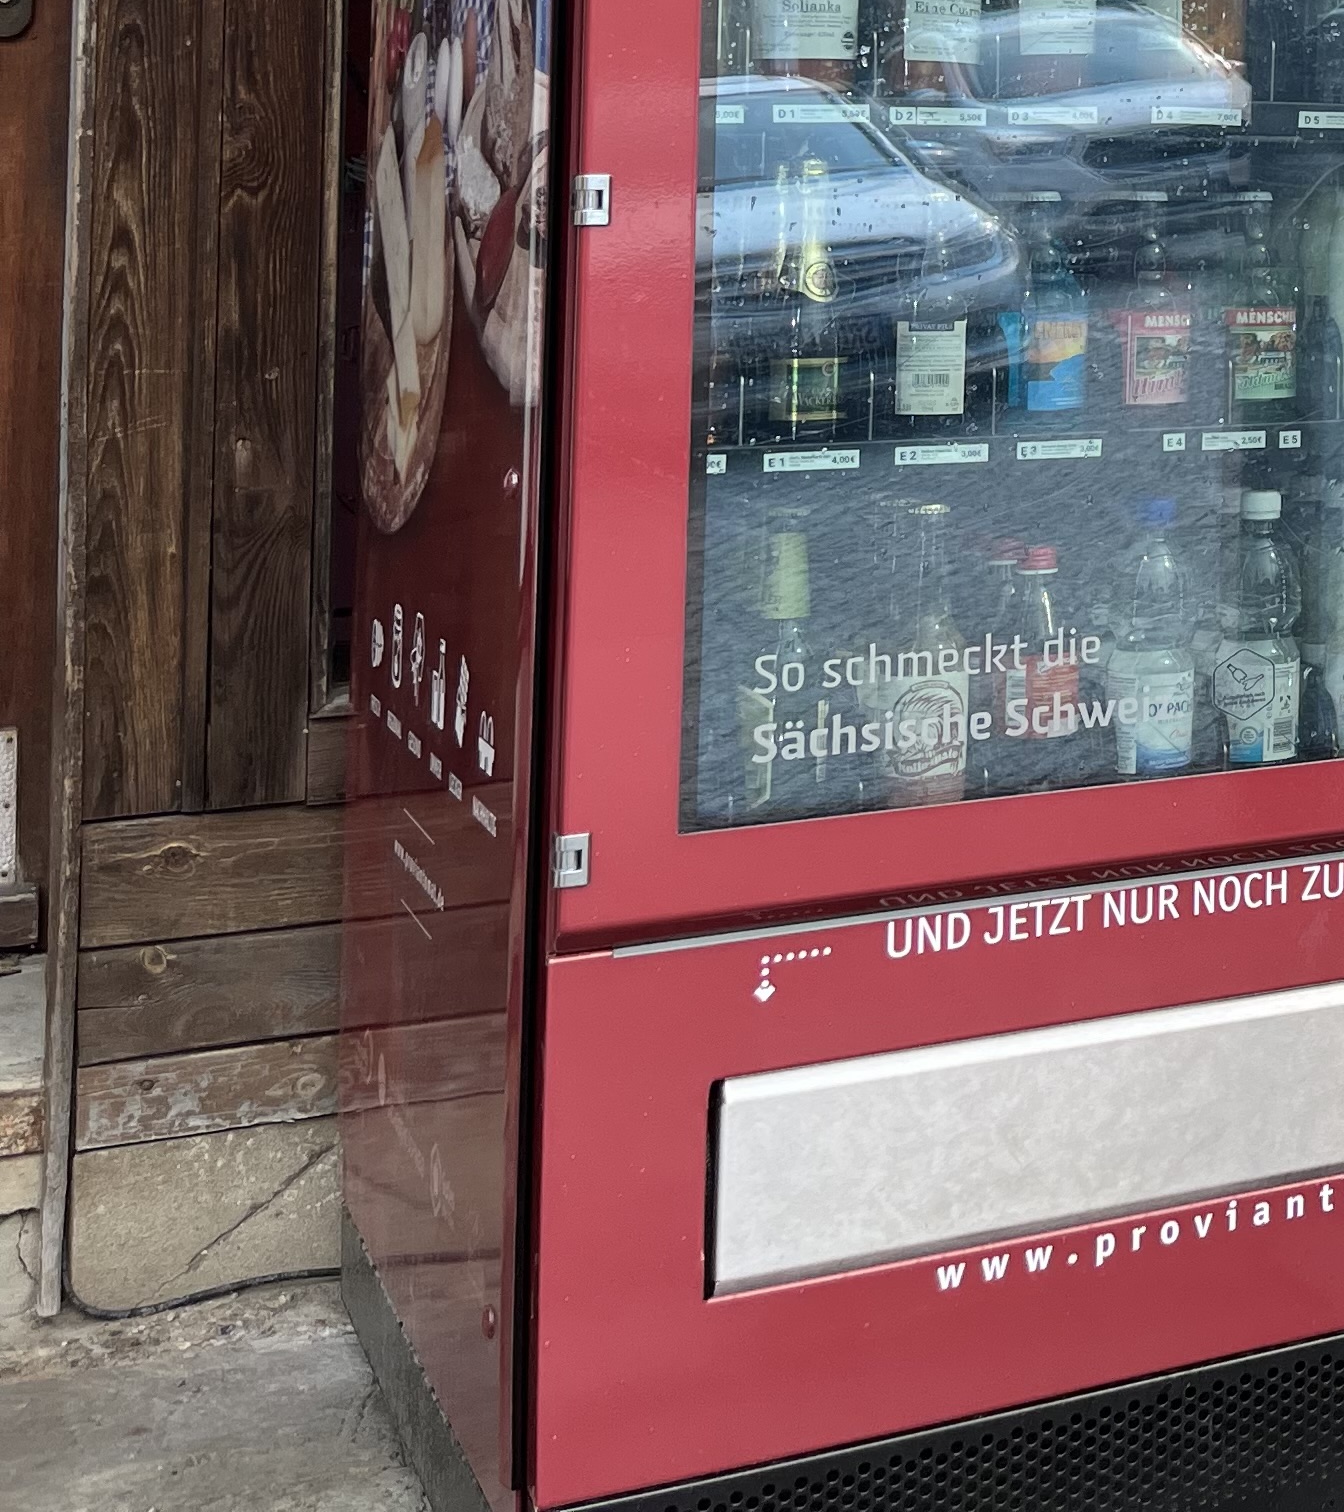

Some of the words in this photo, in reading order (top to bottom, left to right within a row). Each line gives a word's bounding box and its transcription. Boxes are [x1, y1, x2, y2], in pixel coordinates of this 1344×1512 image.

[782, 0, 842, 14] Soljanka
[1241, 436, 1262, 445] 2,50€
[768, 458, 776, 467] E
[831, 455, 856, 465] 4,00€
[961, 450, 982, 459] 3,00€
[753, 653, 804, 696] So
[822, 633, 1027, 690] schmeckt
[1043, 626, 1102, 667] die
[750, 707, 992, 767] Sächsische
[885, 913, 972, 961] UND
[981, 895, 1092, 946] JETZT
[1101, 884, 1180, 930] NUR
[1192, 872, 1290, 917] NOCH
